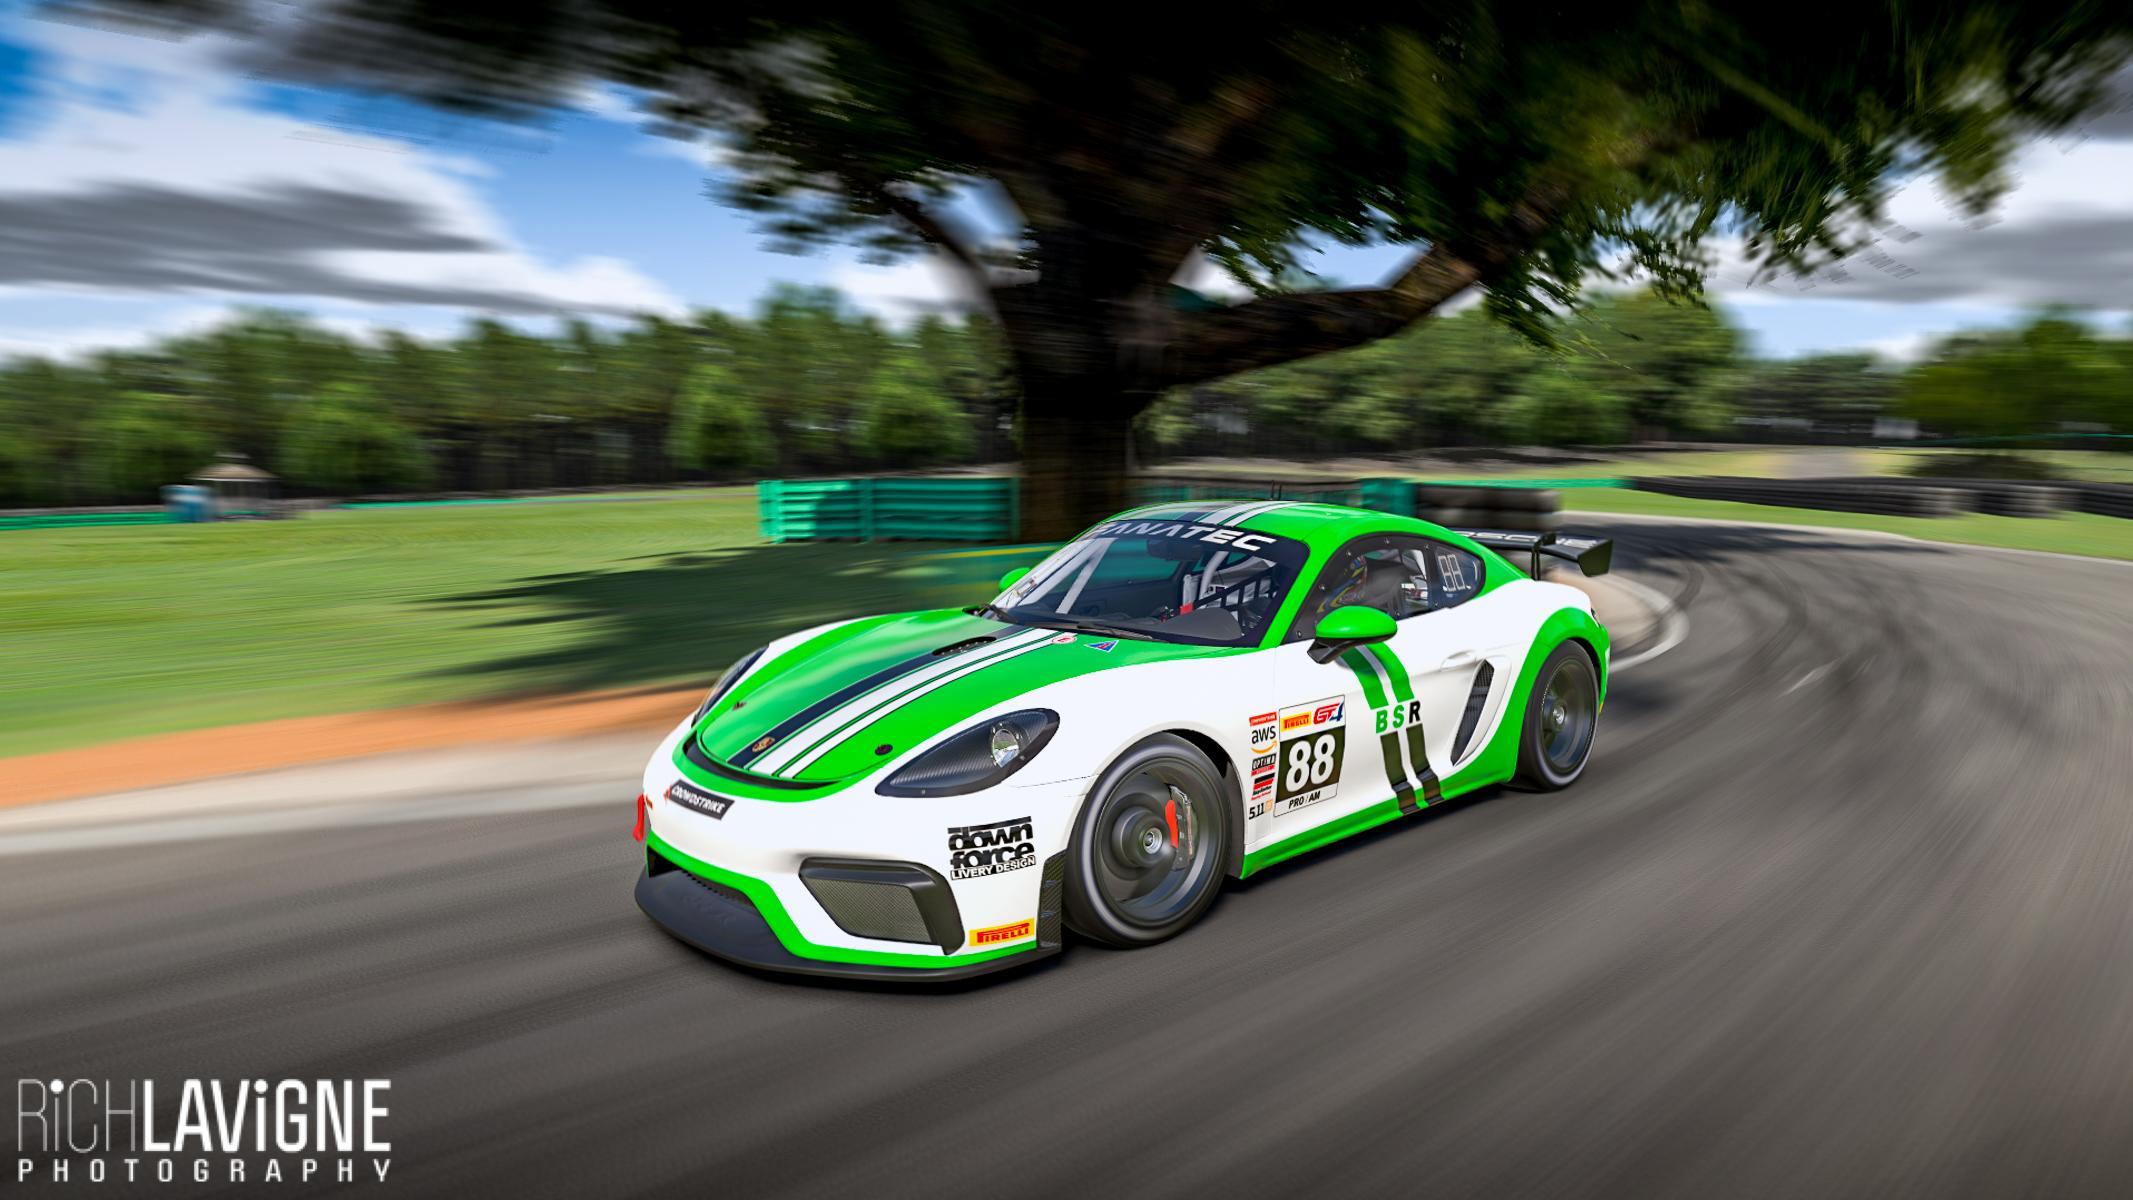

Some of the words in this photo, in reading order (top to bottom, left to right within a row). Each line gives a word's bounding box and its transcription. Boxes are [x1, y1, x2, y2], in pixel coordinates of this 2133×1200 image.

[1086, 521, 1277, 551] FANATEC
[1284, 714, 1309, 729] PIRELLI
[1313, 702, 1345, 725] GT4
[1251, 726, 1276, 744] aws
[1286, 734, 1335, 792] 88
[948, 823, 1034, 850] down
[950, 842, 1035, 870] force
[951, 865, 993, 880] LIVERY
[996, 855, 1035, 874] DESIGN
[977, 922, 1030, 943] PIRELLI
